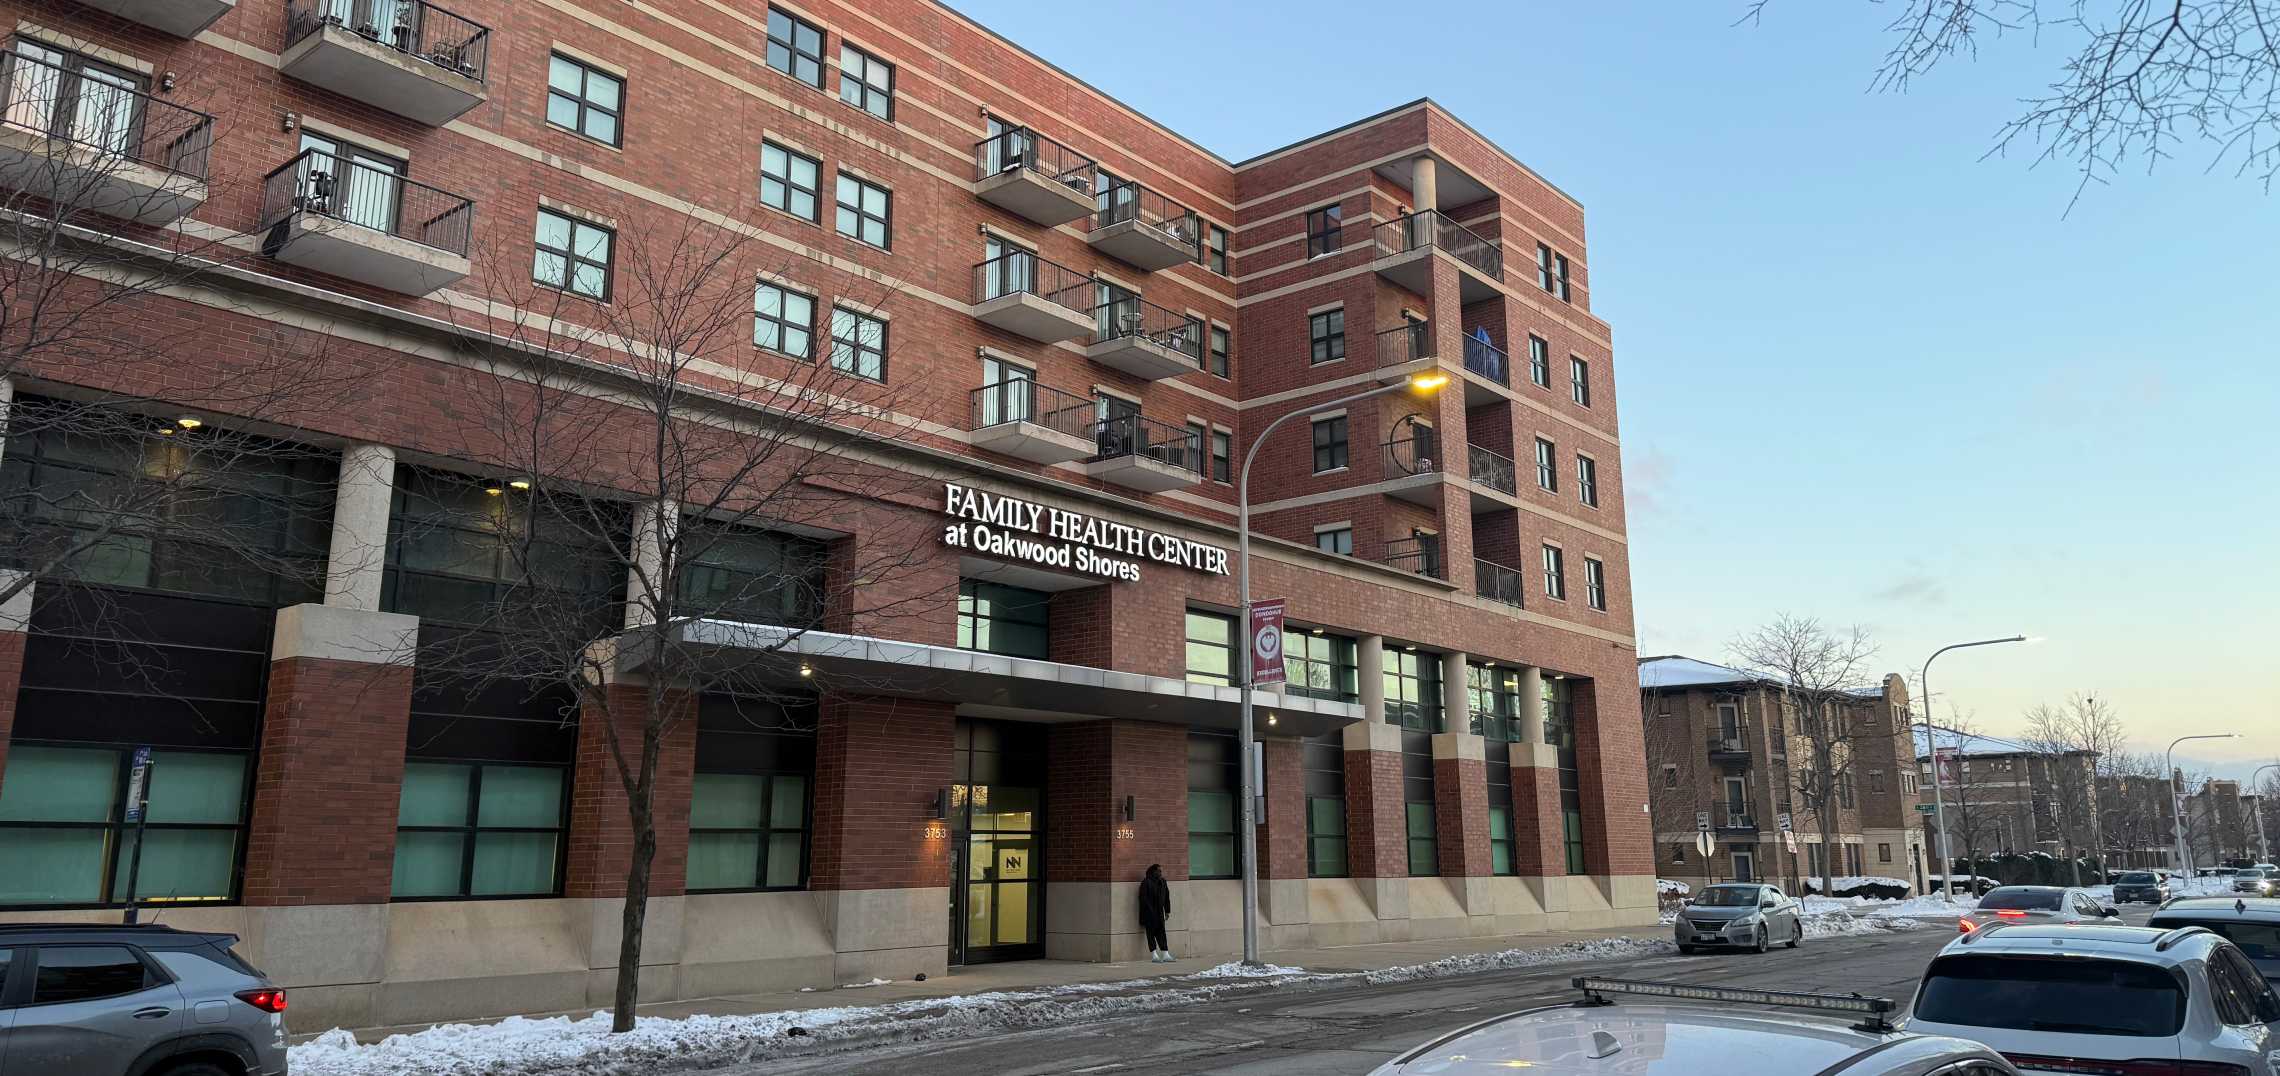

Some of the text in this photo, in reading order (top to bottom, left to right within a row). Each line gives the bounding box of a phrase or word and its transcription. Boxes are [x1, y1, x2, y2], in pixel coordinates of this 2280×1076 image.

[945, 483, 1231, 576] FAMILY HEALTH CENTER
[945, 524, 1140, 582] at Oakwood Shores
[924, 827, 946, 839] 3753
[1116, 829, 1134, 839] 3755
